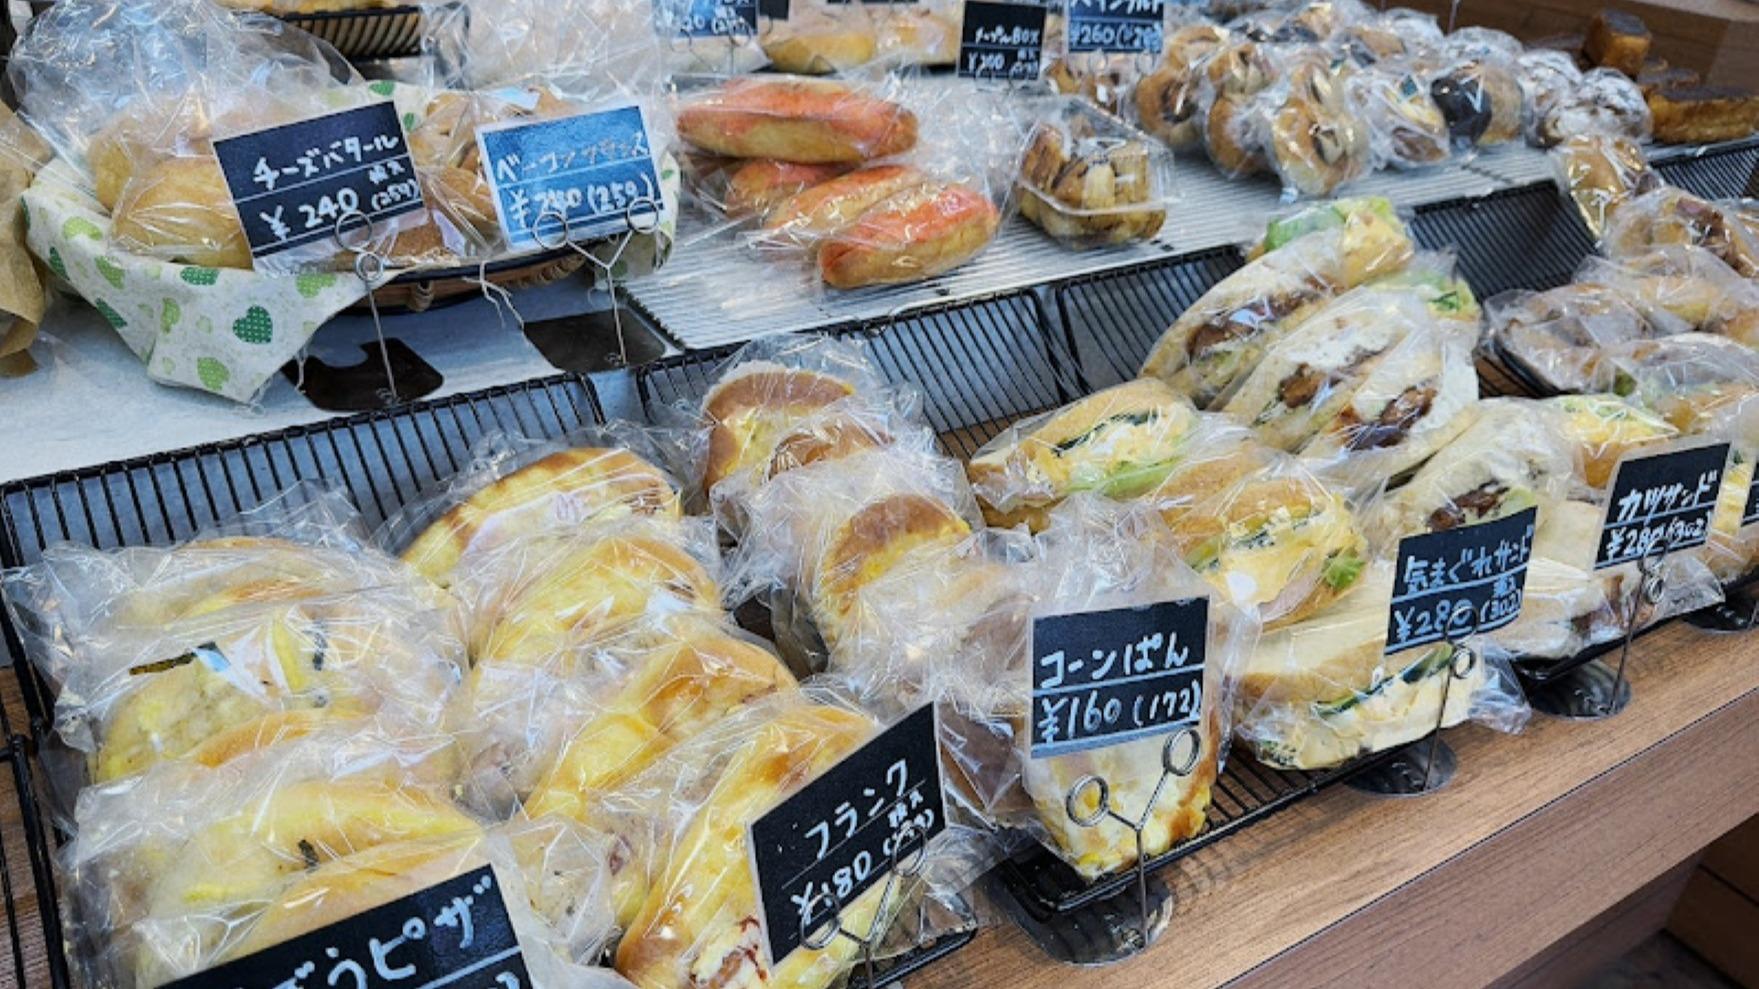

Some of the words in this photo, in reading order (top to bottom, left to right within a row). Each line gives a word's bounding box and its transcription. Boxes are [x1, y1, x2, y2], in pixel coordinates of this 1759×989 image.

[253, 135, 400, 191] チーズバタール
[259, 187, 360, 241] ¥240
[1617, 469, 1718, 526] カツサンド
[1403, 524, 1535, 596] 気まぐれサンド
[1040, 631, 1189, 689] コーンぱん
[1037, 689, 1122, 744] ¥160
[1133, 679, 1201, 728] (172)
[804, 758, 909, 860] フランク
